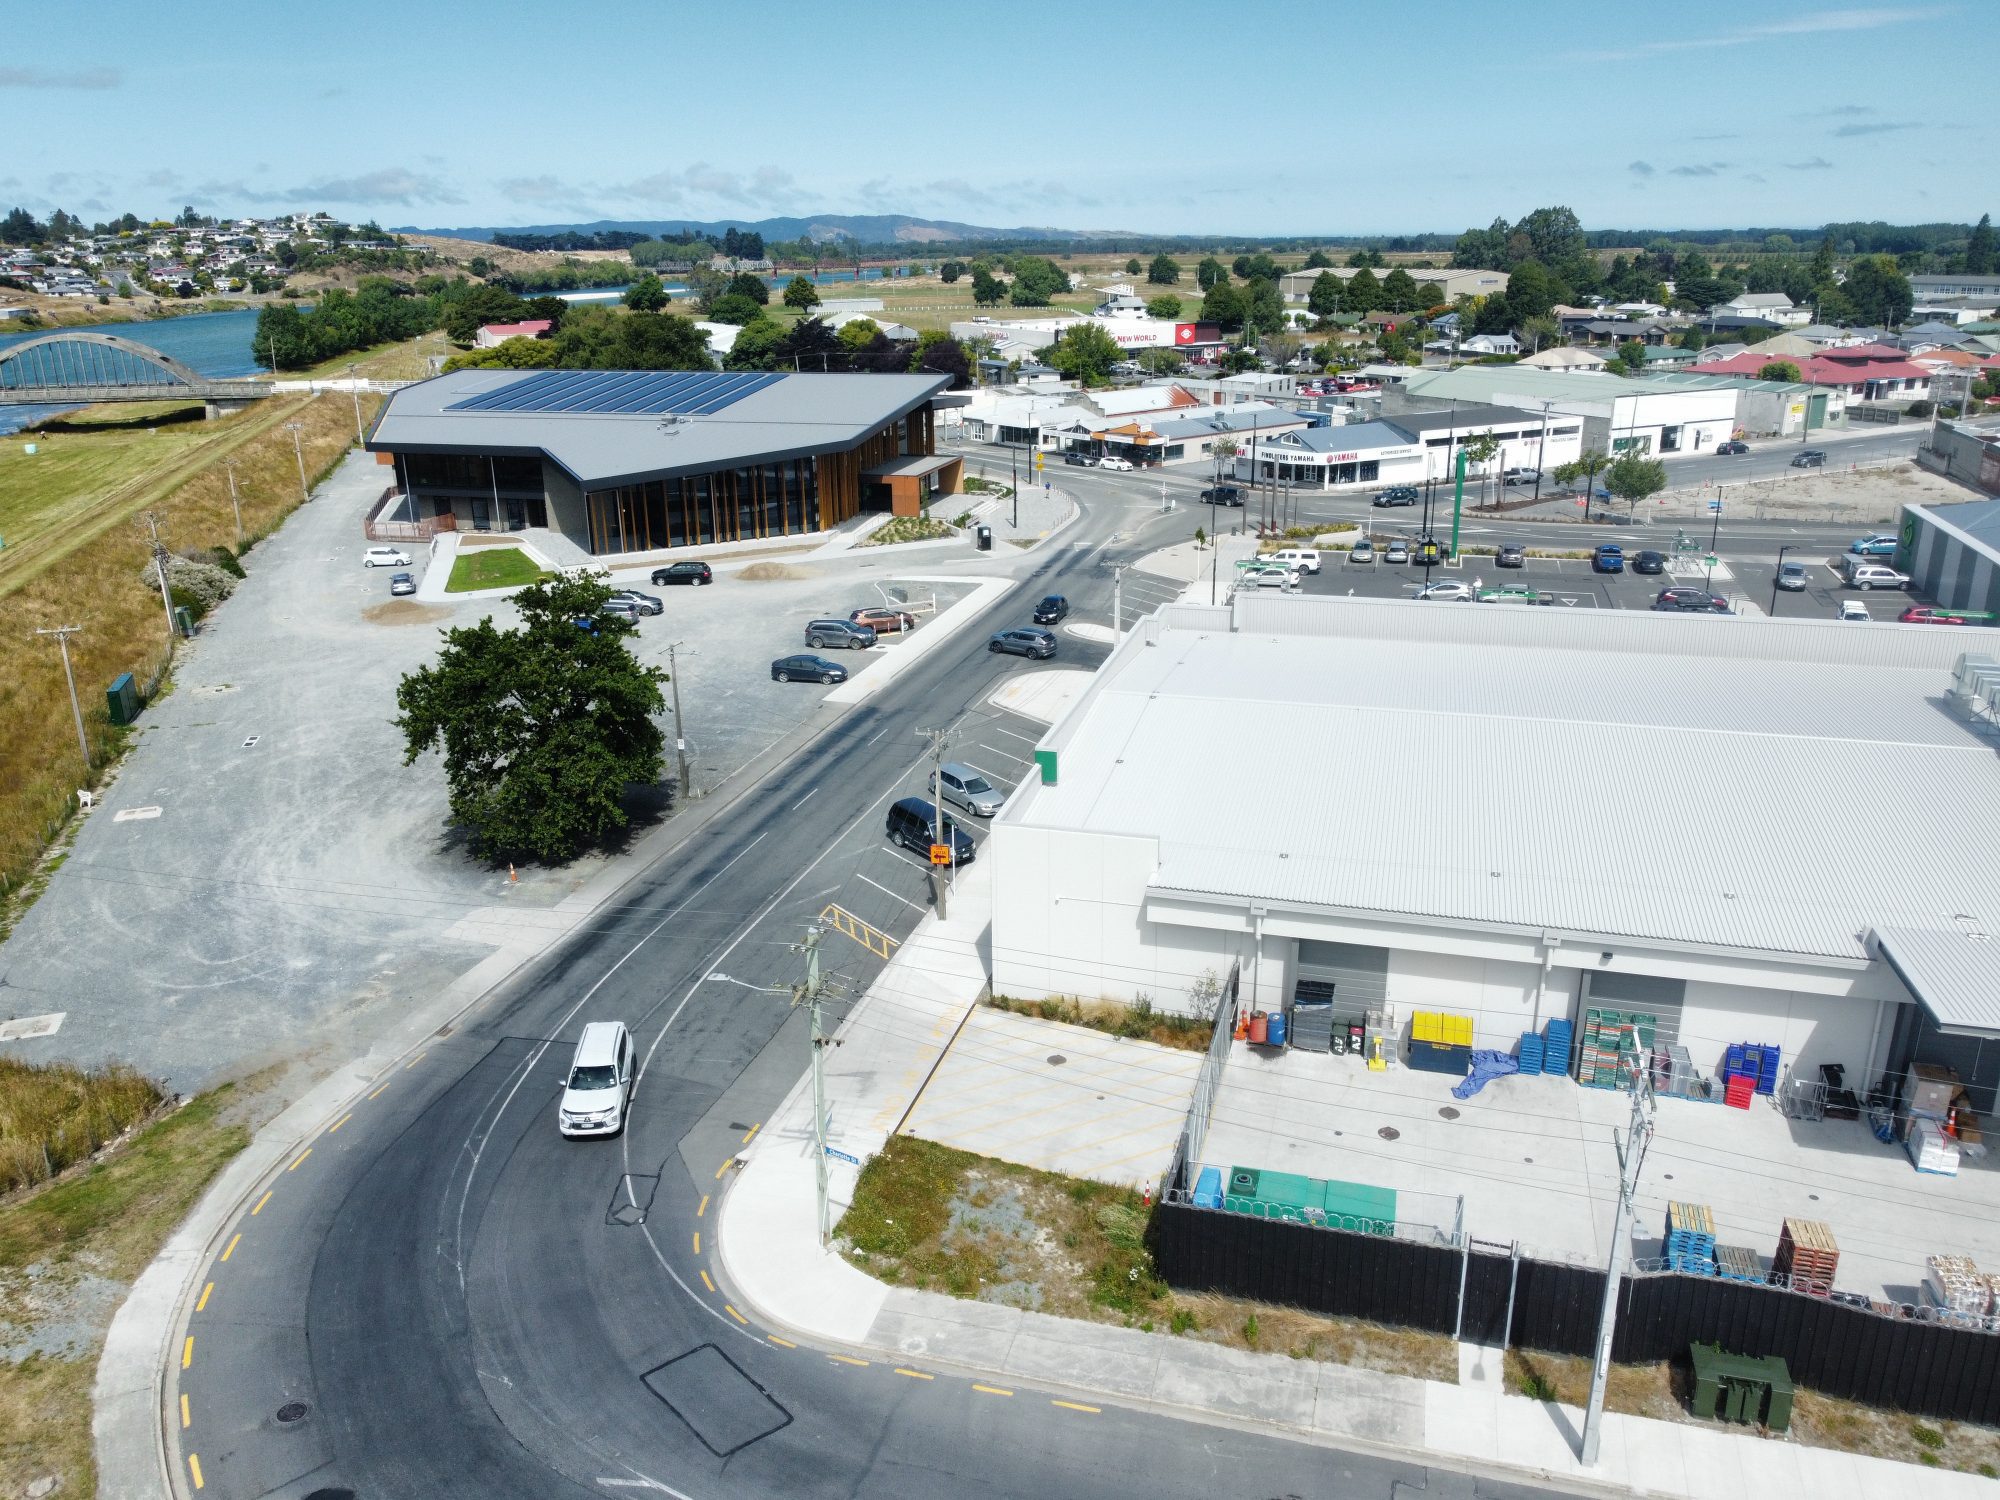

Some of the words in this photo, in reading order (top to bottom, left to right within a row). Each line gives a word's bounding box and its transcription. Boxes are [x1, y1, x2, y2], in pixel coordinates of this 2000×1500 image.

[1117, 335, 1133, 343] NEW
[1133, 334, 1157, 342] WORLD
[1262, 451, 1289, 461] FINDLERS
[1334, 452, 1358, 462] YAMAHA
[829, 1149, 851, 1161] Charlotte
[851, 1156, 858, 1165] St
